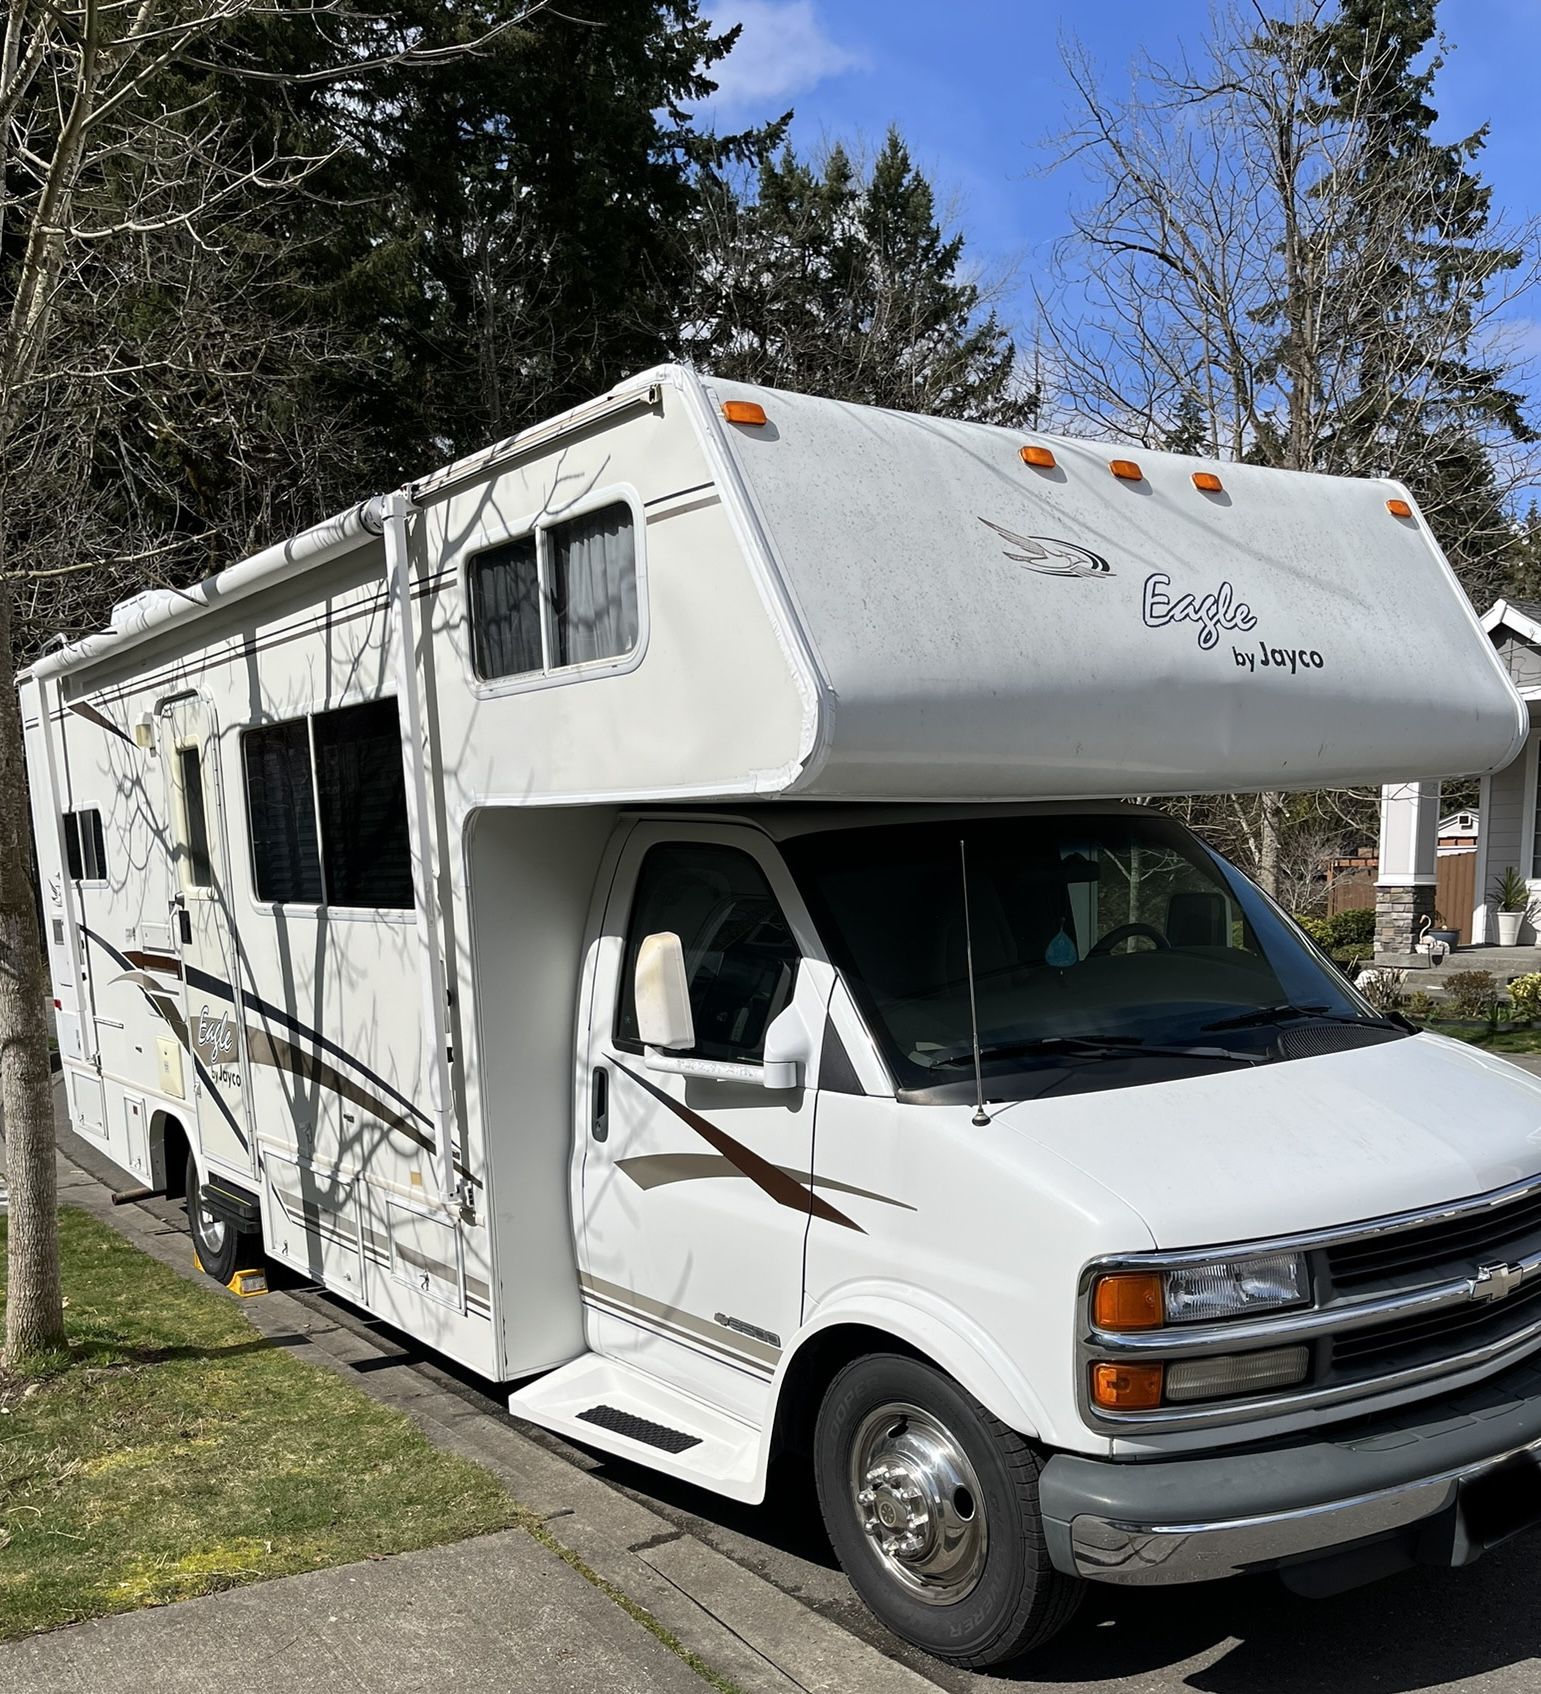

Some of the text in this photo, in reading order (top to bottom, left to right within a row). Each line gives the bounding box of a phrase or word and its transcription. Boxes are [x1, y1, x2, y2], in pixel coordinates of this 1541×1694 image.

[1143, 573, 1257, 649] Eagle
[1232, 641, 1324, 674] by Jayco
[199, 1005, 232, 1063] Eagle
[220, 1065, 241, 1088] Jayco
